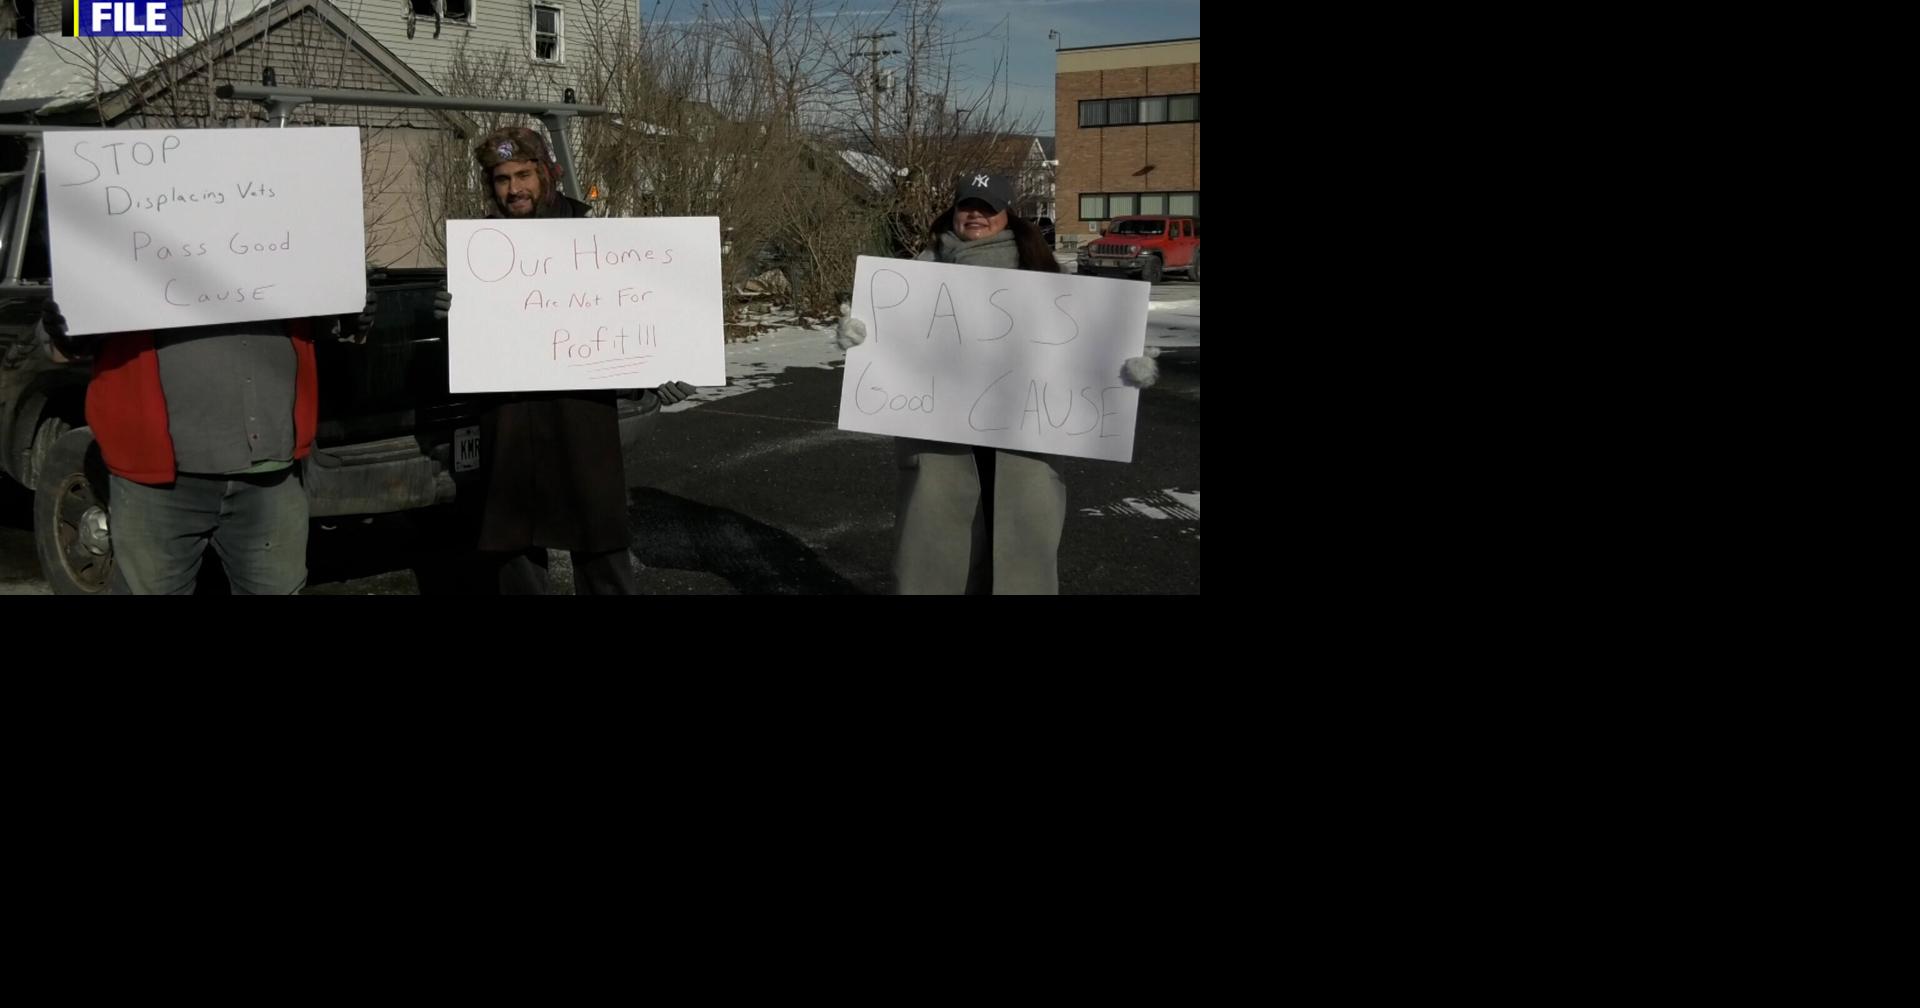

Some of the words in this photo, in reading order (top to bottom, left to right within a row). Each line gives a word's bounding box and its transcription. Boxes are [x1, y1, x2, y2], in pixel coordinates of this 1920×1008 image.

[60, 135, 180, 187] STOP
[105, 186, 225, 216] Displacing
[236, 181, 276, 198] Vets
[133, 231, 208, 261] Pass
[229, 231, 290, 255] Good
[467, 228, 553, 283] Our
[573, 234, 673, 271] Homes
[524, 289, 559, 310] Are
[568, 292, 600, 308] Not
[618, 287, 653, 307] For
[870, 268, 1079, 346] PASS
[855, 361, 935, 415] Good
[968, 370, 1122, 438] CAUSE
